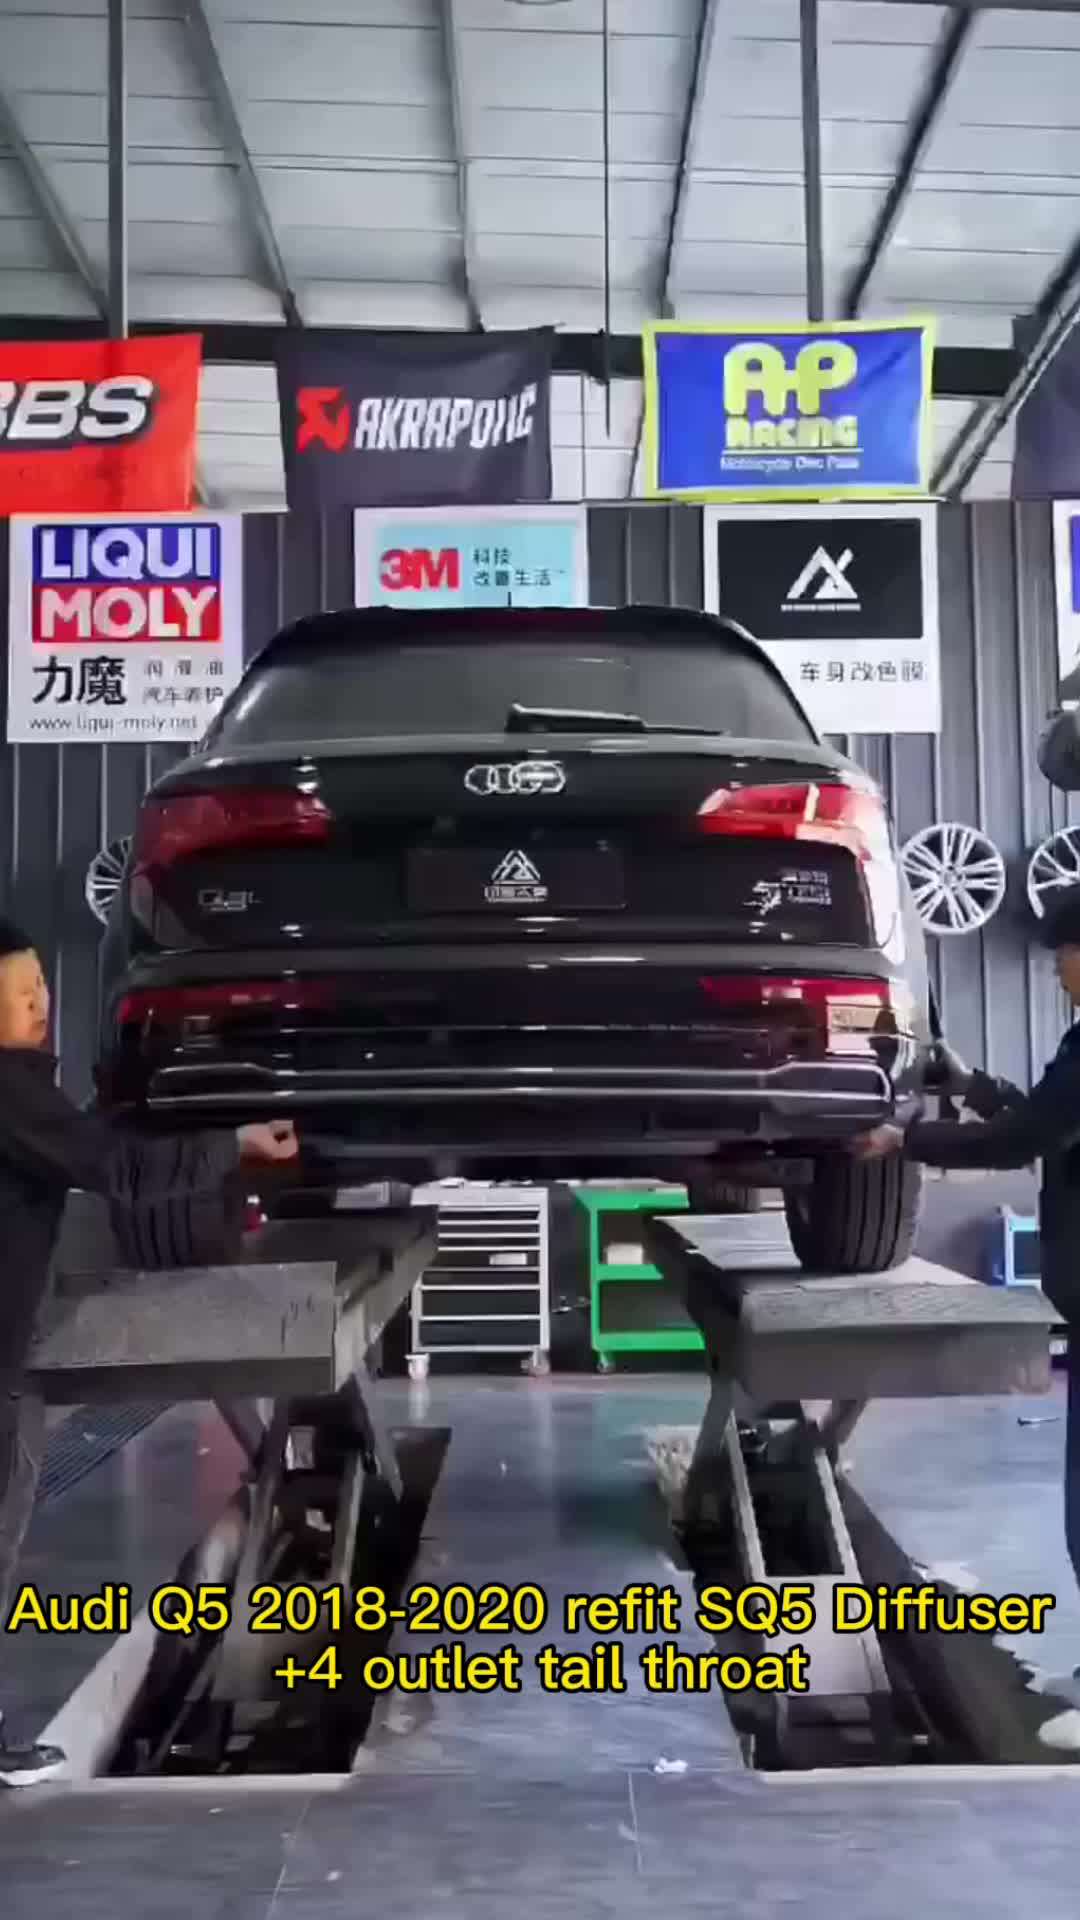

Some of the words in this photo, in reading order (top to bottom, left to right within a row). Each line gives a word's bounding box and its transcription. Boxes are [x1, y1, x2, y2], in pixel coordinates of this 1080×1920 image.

[724, 339, 858, 416] AP
[0, 375, 153, 439] BS
[41, 527, 212, 580] LIQUI
[380, 547, 460, 591] 3M
[41, 586, 217, 639] MOLY
[32, 655, 126, 705] 力魔
